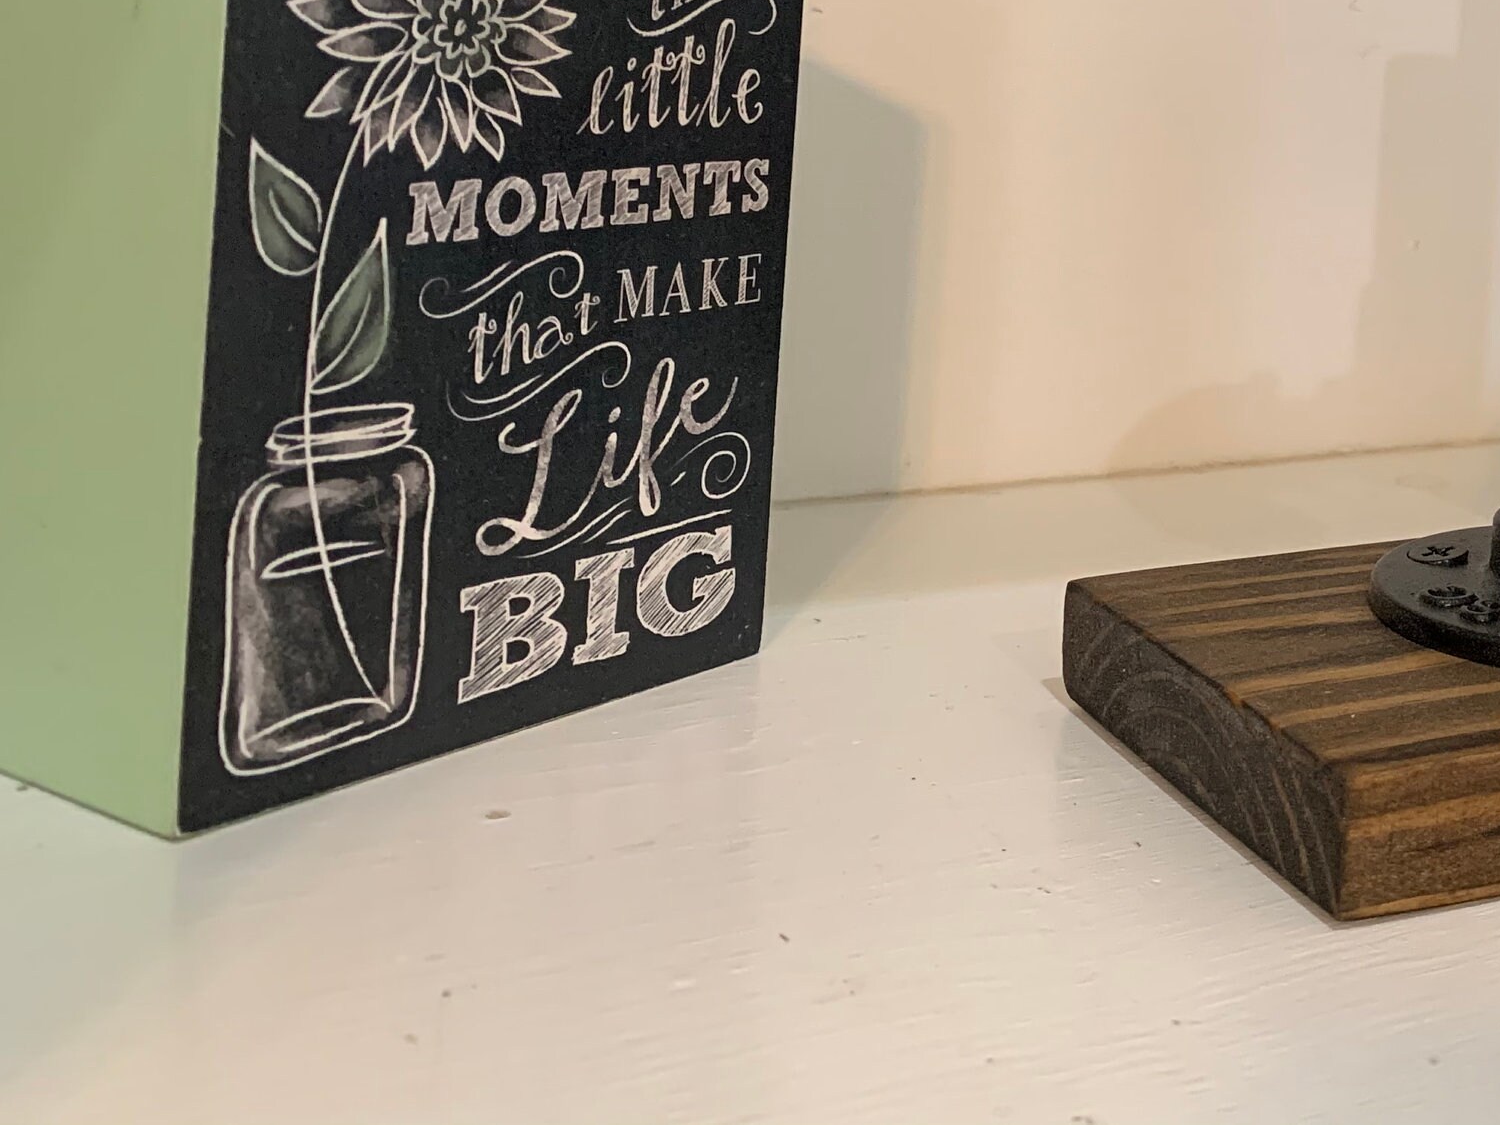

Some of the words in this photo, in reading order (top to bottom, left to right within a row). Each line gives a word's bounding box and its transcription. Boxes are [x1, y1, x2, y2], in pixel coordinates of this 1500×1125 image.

[576, 18, 763, 135] little
[405, 158, 770, 246] MOMENTS
[468, 291, 600, 385] that
[613, 253, 762, 324] MAKE
[475, 357, 739, 556] Life
[457, 524, 736, 705] BIG
